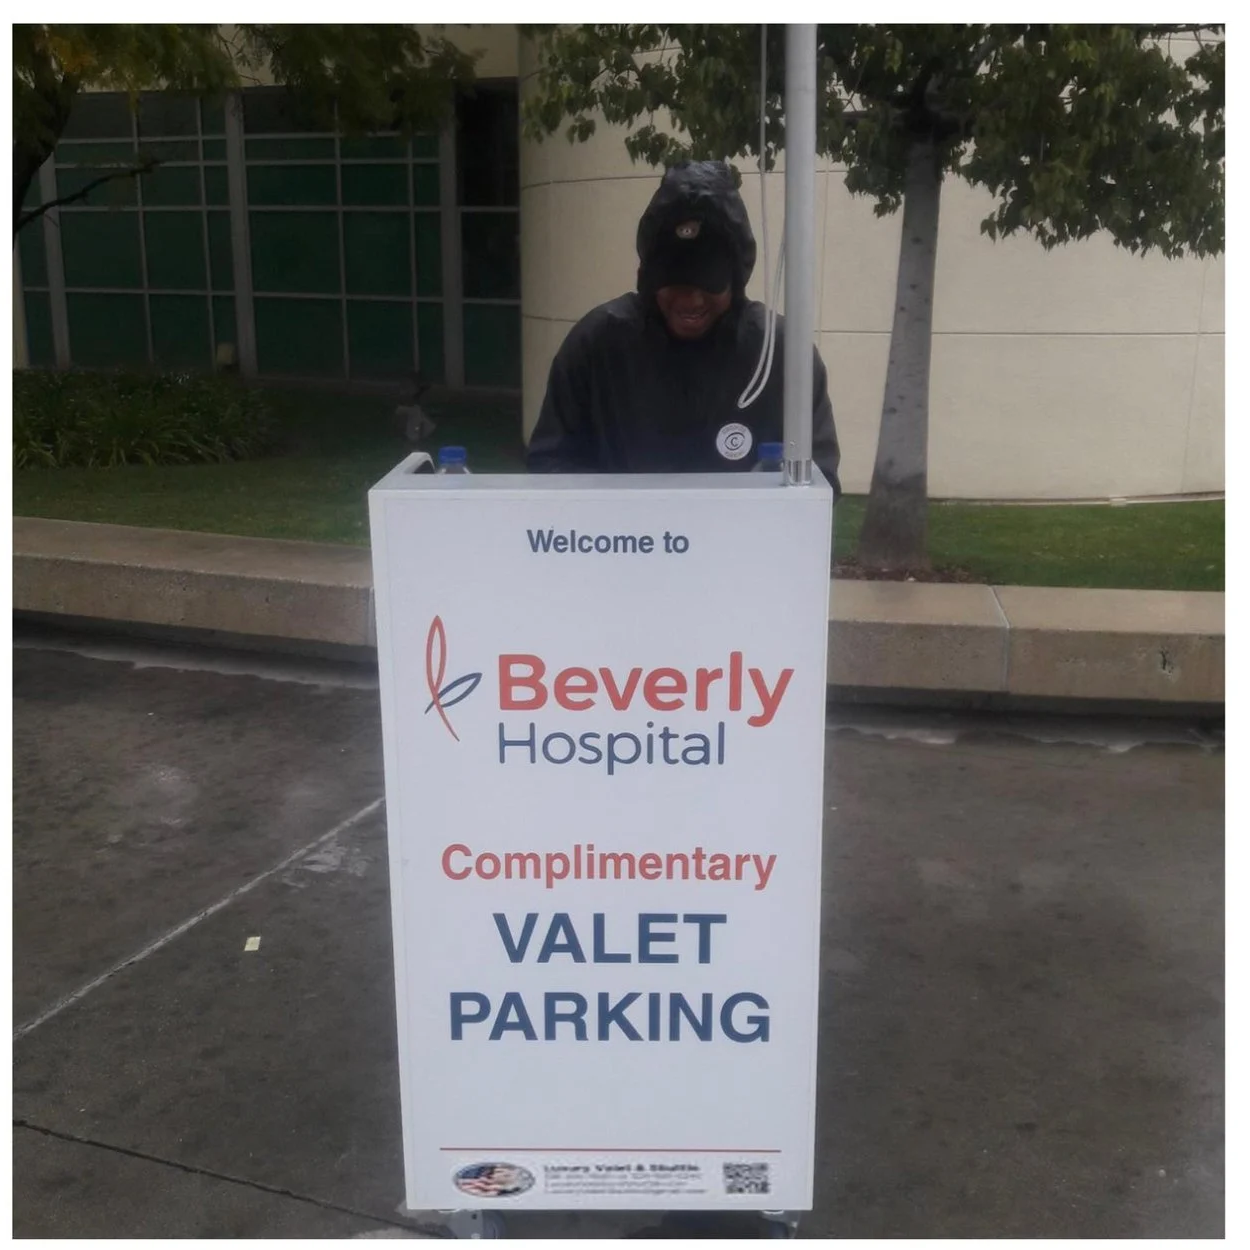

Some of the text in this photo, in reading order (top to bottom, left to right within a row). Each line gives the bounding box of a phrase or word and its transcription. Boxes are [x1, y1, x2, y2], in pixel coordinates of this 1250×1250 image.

[527, 529, 689, 554] Welcome to
[498, 651, 795, 728] Beverly
[498, 721, 725, 776] Hospital
[441, 844, 777, 891] Complimentary
[492, 913, 727, 964] VALET
[450, 992, 770, 1043] PARKING
